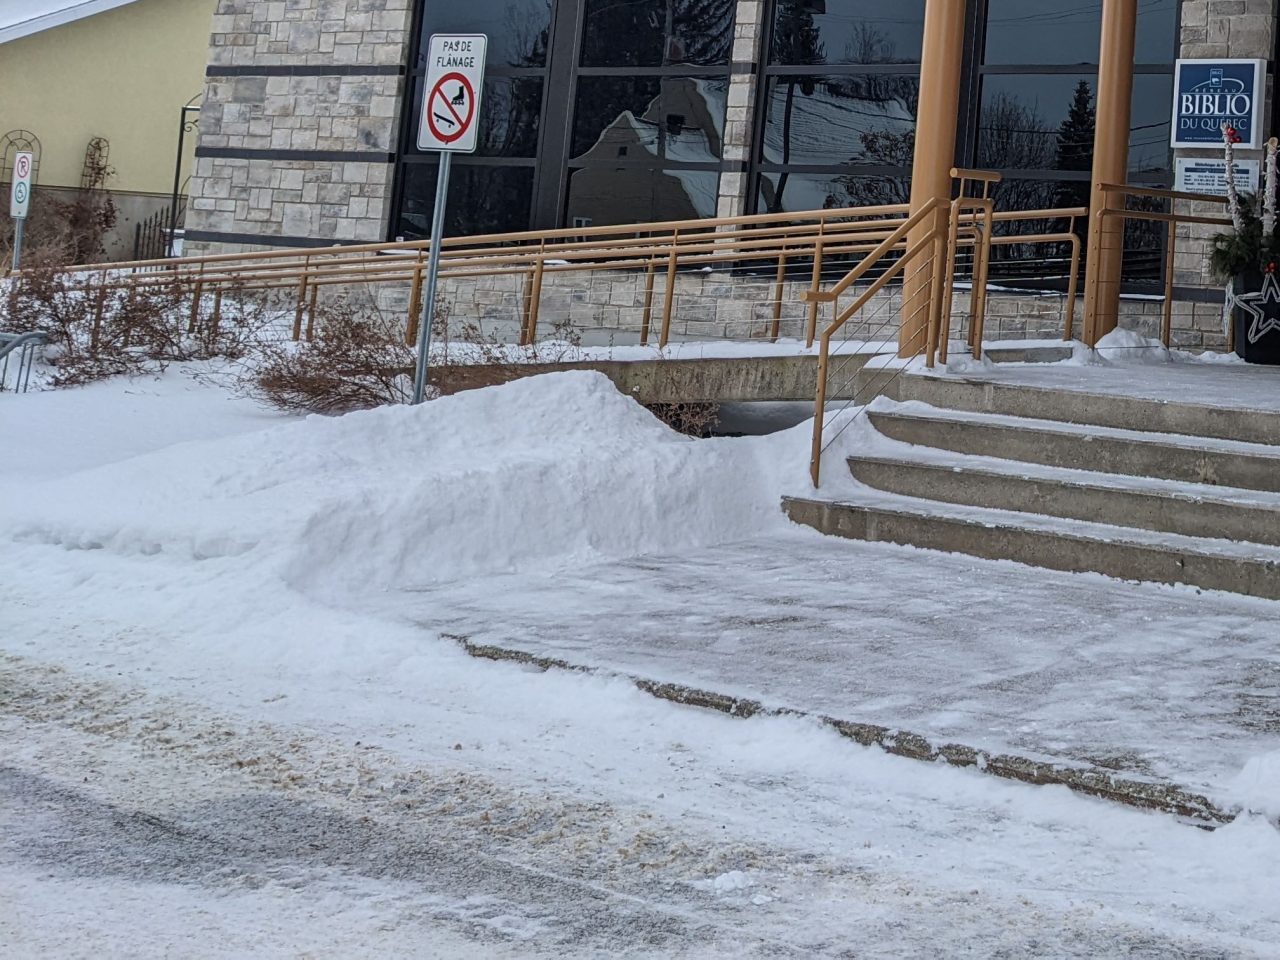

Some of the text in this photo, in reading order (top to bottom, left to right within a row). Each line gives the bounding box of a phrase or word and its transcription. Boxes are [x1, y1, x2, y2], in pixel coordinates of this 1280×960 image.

[443, 41, 472, 52] PAS DE
[436, 54, 475, 68] FLÂNAGE
[1181, 94, 1251, 116] BIBLIO
[1181, 118, 1198, 129] DU
